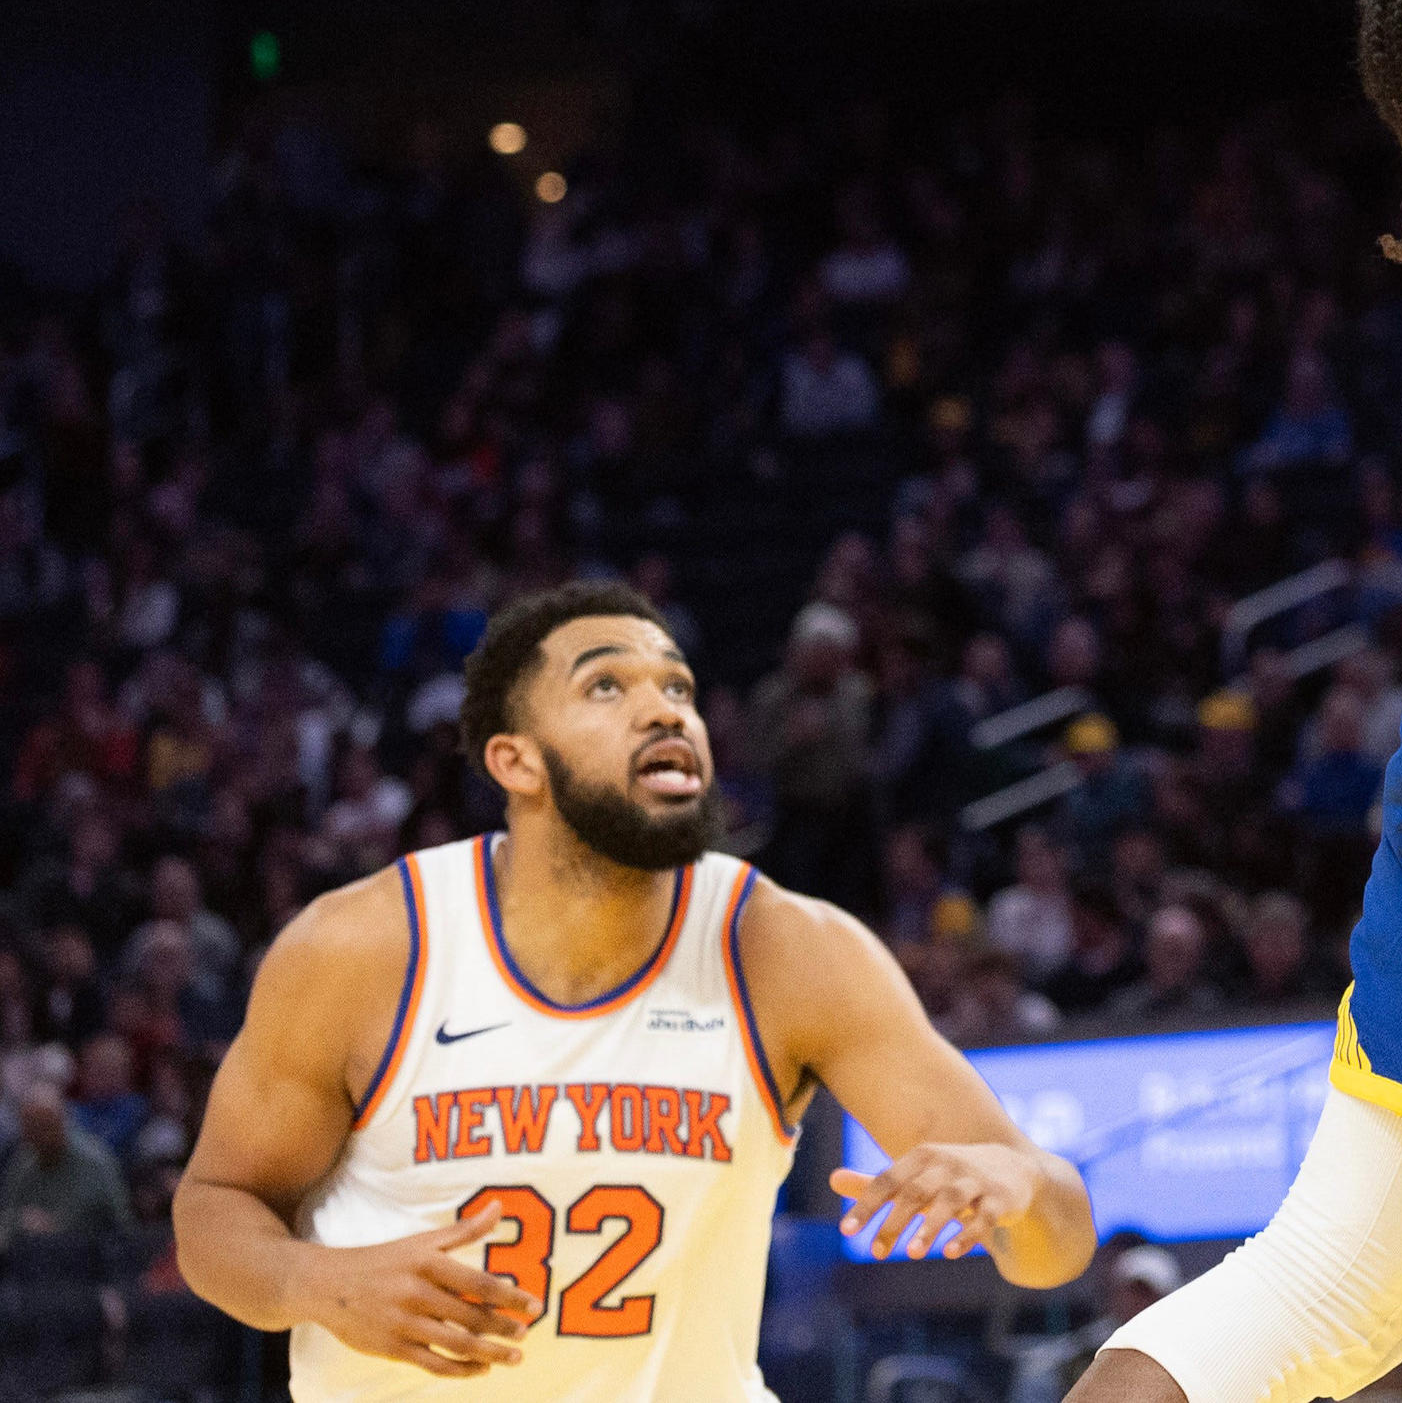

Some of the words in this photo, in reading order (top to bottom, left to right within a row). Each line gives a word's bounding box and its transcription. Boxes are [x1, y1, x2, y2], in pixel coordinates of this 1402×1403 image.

[412, 1085, 557, 1164] NEW
[566, 1083, 733, 1164] YORK
[456, 1184, 665, 1339] 32
